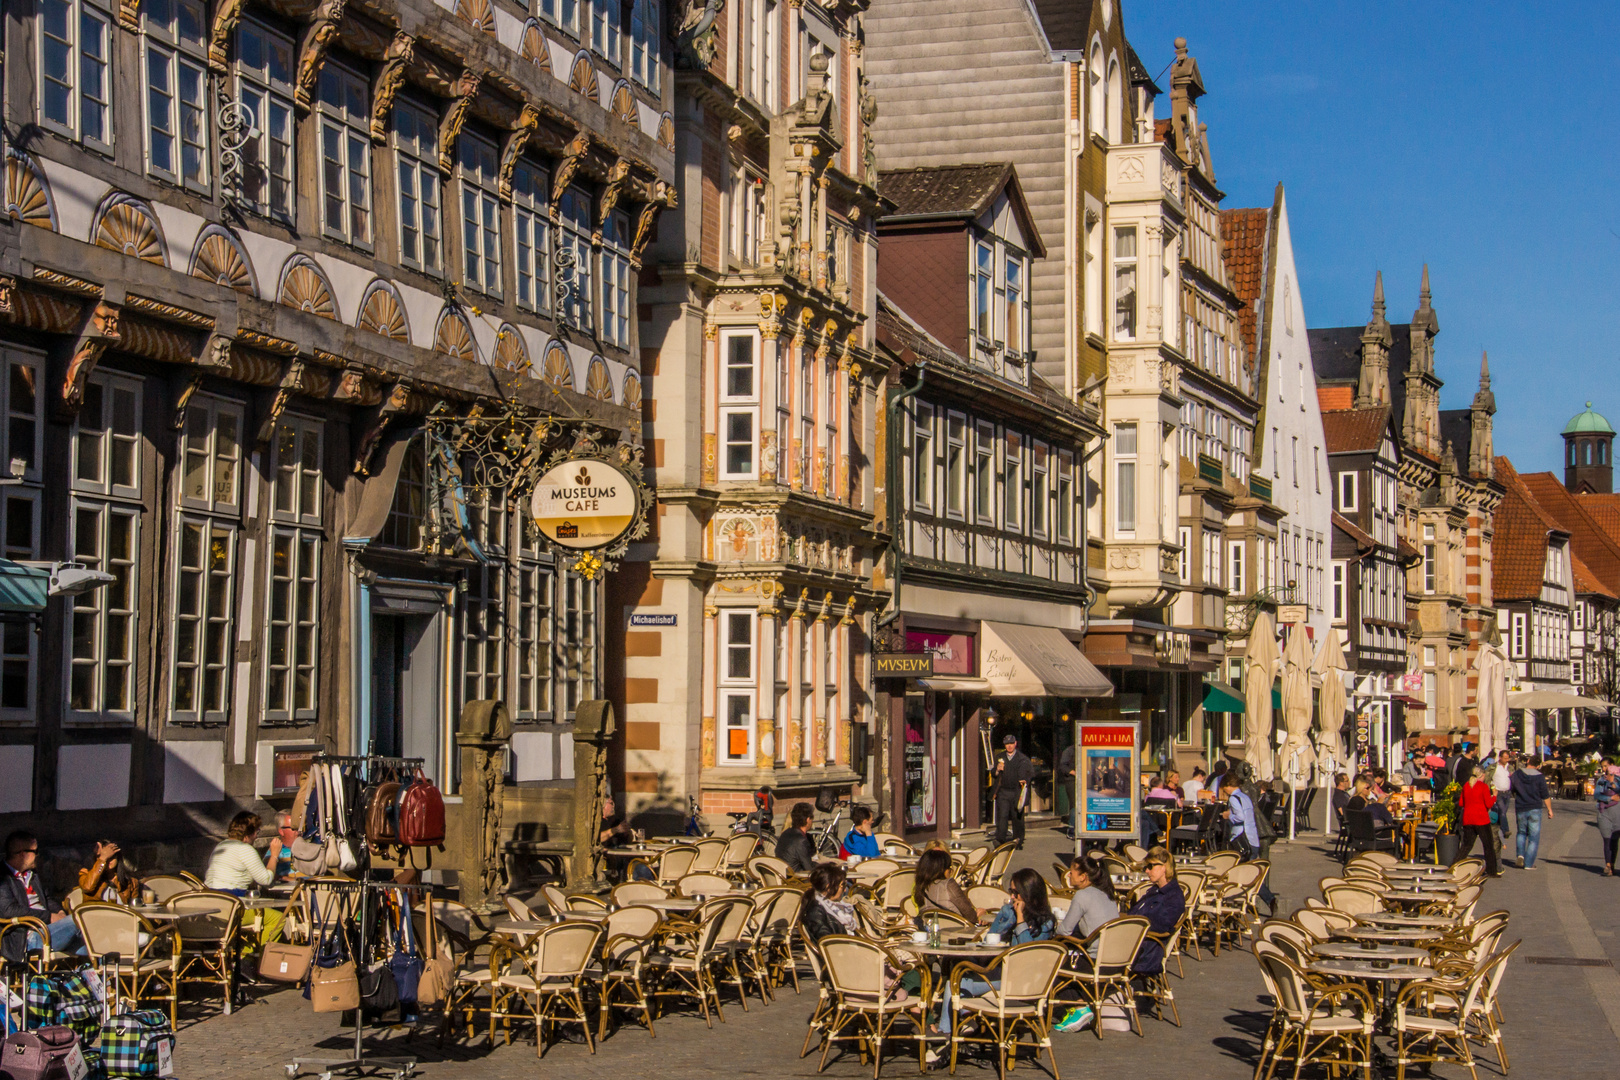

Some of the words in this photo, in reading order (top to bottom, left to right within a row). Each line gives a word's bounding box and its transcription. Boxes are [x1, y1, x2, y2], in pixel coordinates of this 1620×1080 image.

[551, 487, 616, 500] MUSEUMS
[565, 498, 599, 512] CAFÉ
[633, 615, 675, 624] Michaelishof
[986, 649, 1012, 663] Bistro
[986, 664, 1017, 680] Eiscafé
[1084, 734, 1132, 743] MUSEUM
